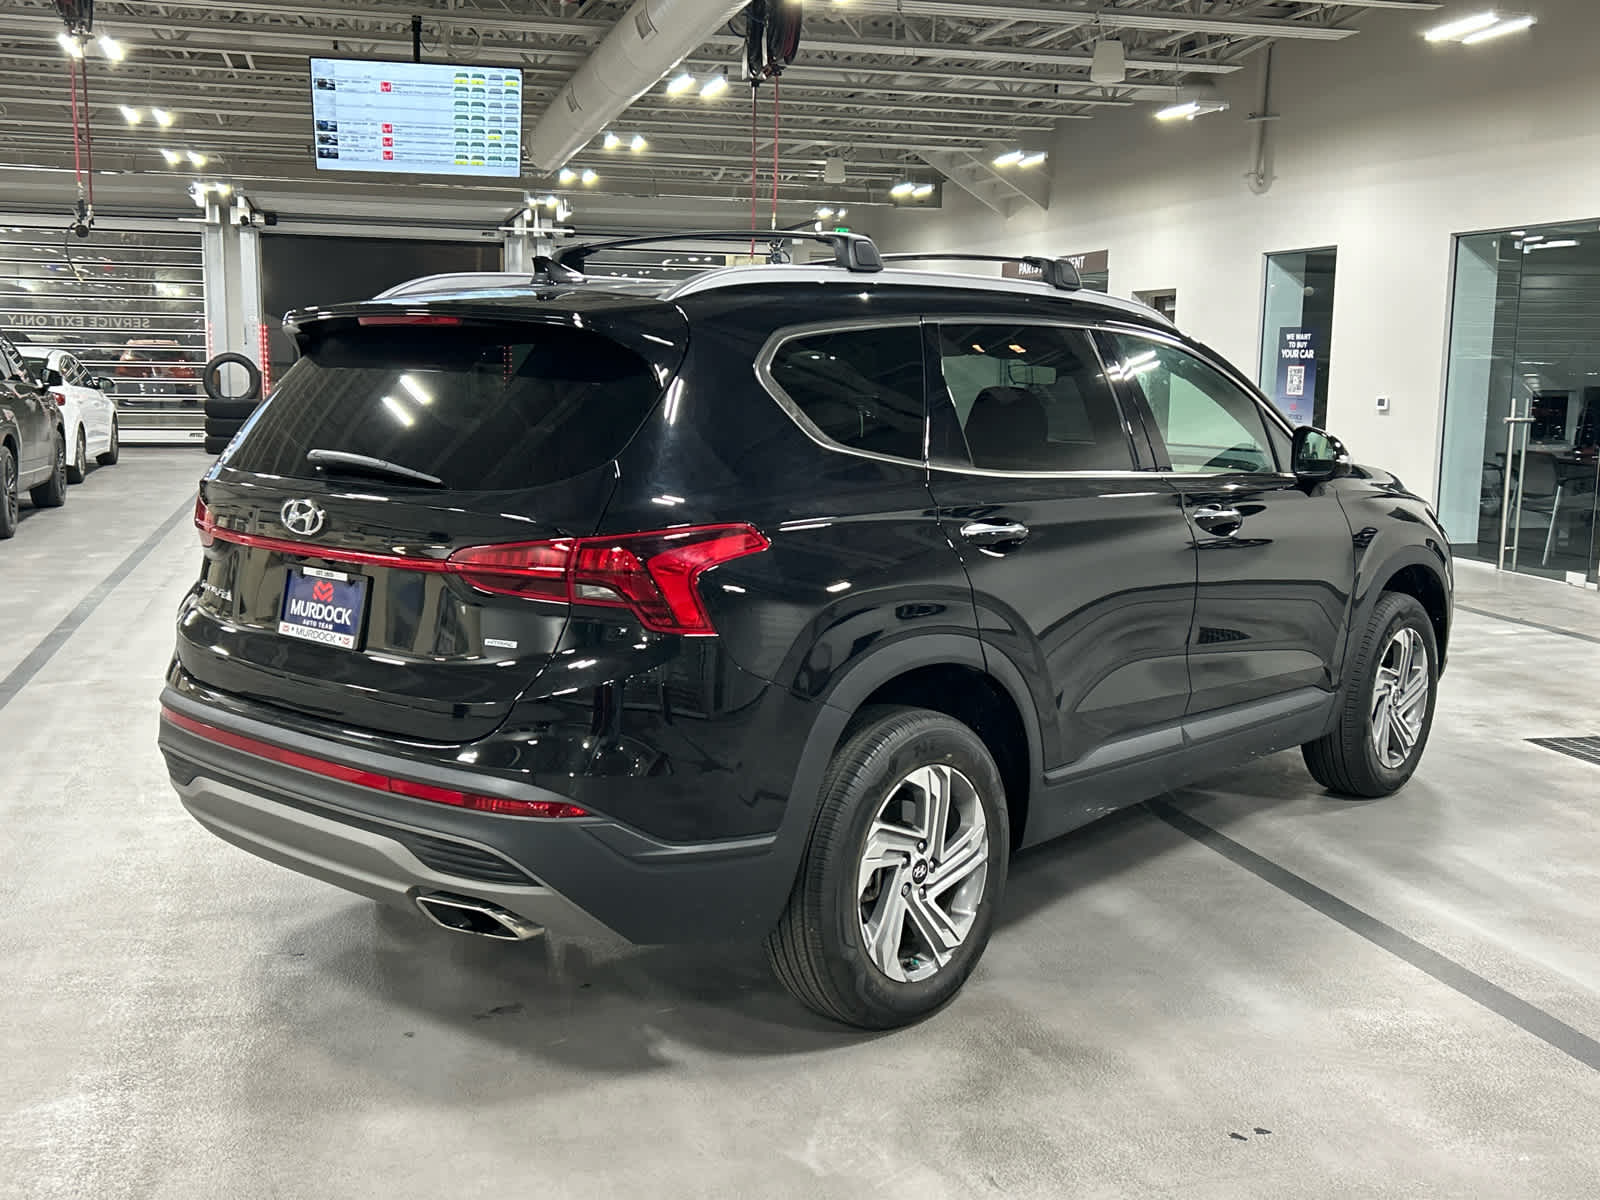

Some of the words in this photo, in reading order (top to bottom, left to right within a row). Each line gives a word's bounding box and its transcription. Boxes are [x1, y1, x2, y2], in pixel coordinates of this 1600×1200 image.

[1281, 349, 1299, 359] YOUR
[1299, 349, 1315, 359] CAR
[290, 598, 352, 626] MURDOCK
[302, 619, 317, 627] AUTO
[318, 621, 334, 630] TEAM
[295, 627, 337, 643] MURDOCK
